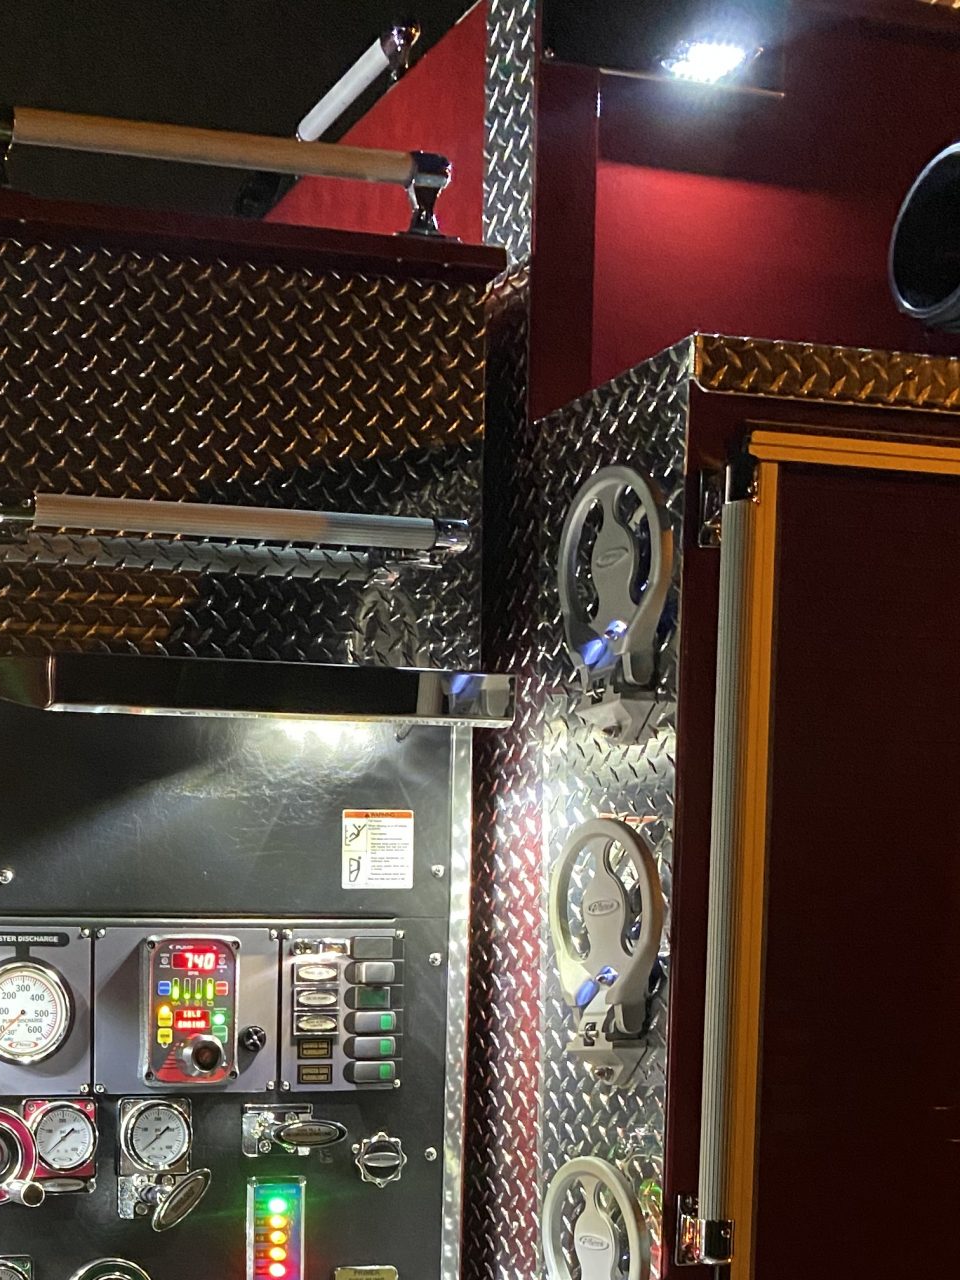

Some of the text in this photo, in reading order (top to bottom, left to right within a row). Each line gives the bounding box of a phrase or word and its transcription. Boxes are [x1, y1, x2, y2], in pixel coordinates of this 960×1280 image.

[185, 953, 216, 969] 740
[16, 984, 30, 992] 300
[2, 992, 16, 1000] 200
[30, 993, 45, 1002] 400
[27, 1026, 42, 1034] 600
